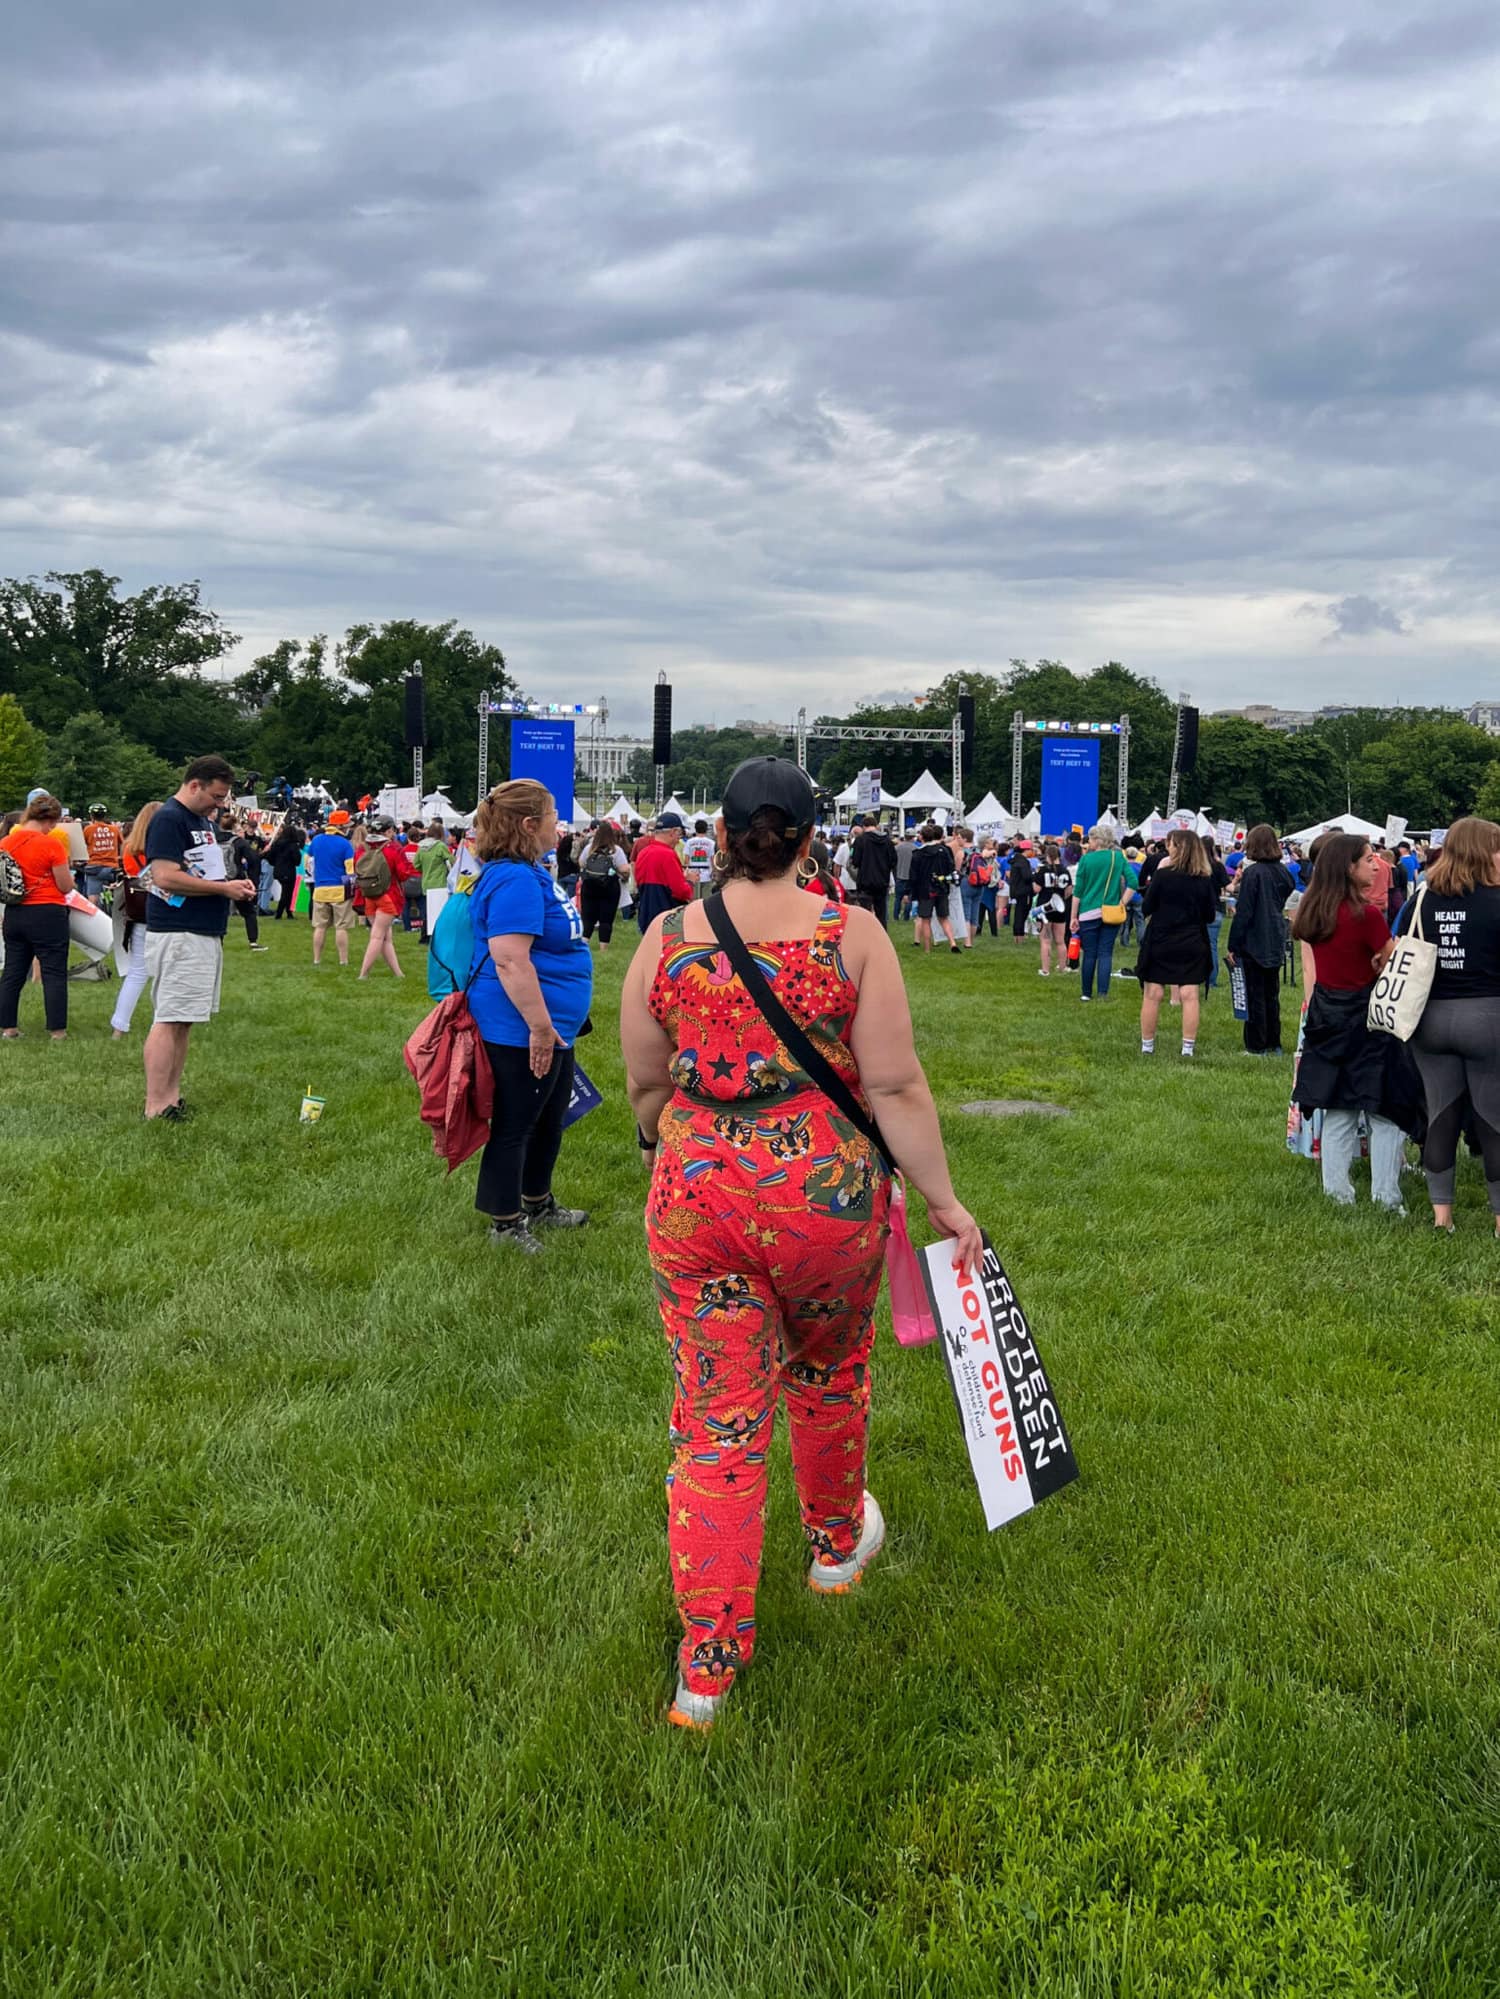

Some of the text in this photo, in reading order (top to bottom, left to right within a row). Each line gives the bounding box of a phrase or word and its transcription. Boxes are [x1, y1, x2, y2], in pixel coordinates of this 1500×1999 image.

[1435, 911, 1466, 921] HEALTH
[1439, 924, 1461, 934] CARE
[1441, 936, 1458, 946] IS A
[1437, 948, 1465, 958] HUMAN
[1440, 960, 1465, 970] RIGHT
[984, 1248, 1067, 1453] PROTECT
[952, 1260, 1023, 1482] NOT GUNS
[968, 1360, 987, 1417] children's
[962, 1362, 986, 1438] defense fund
